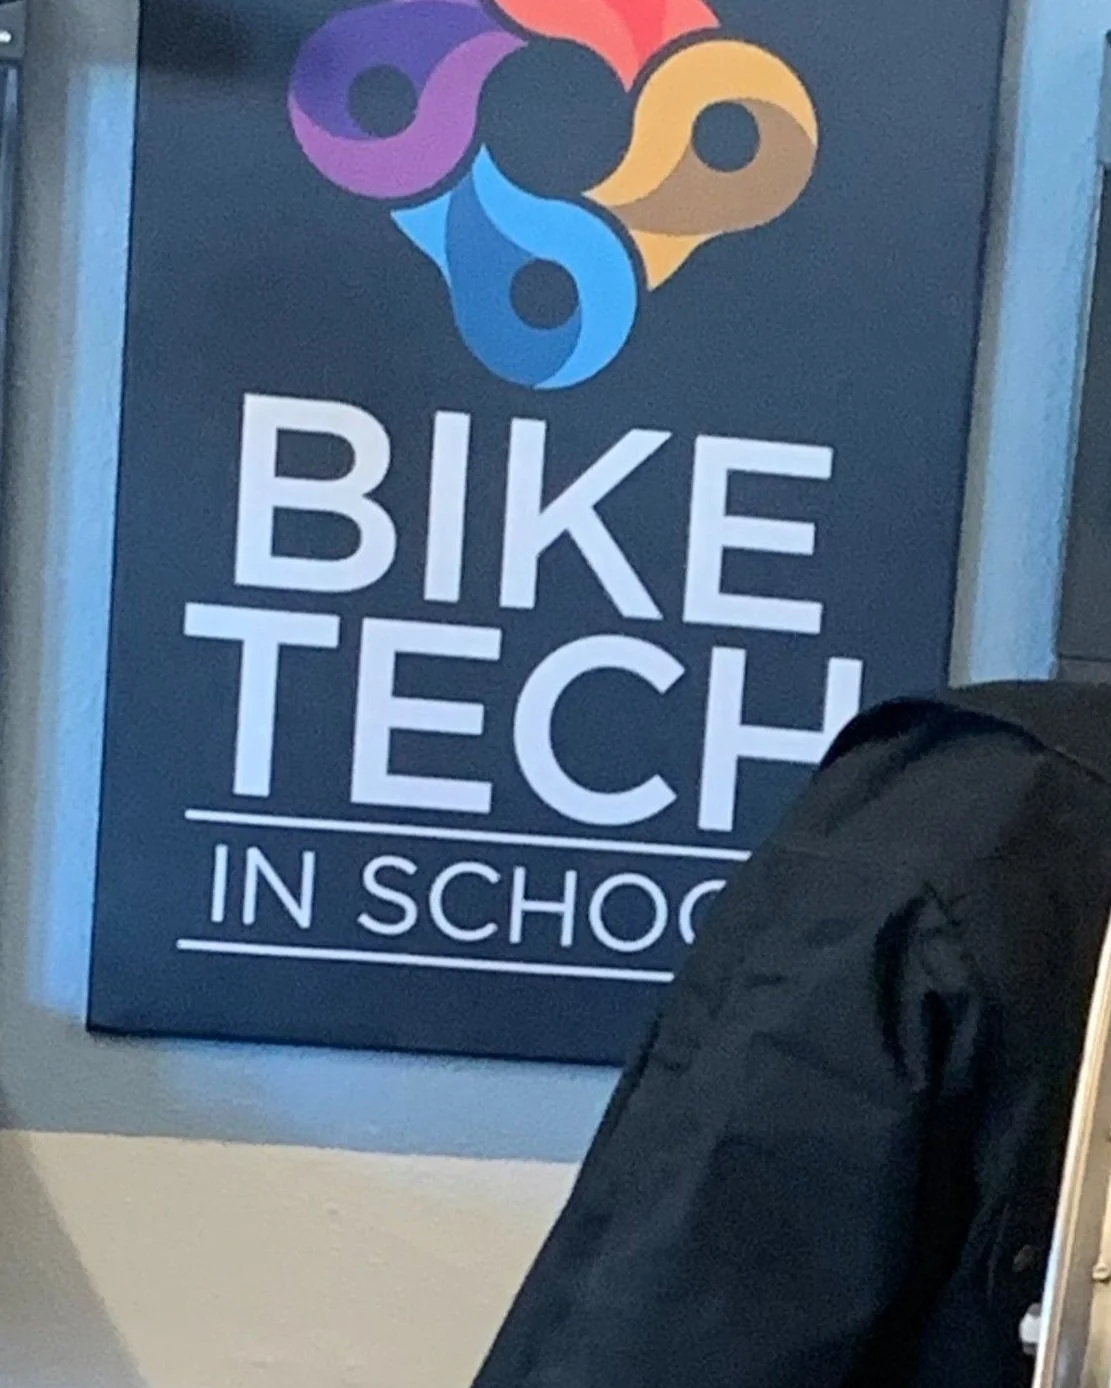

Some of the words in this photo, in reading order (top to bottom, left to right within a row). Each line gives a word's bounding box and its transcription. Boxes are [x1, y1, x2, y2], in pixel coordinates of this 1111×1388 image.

[234, 393, 833, 634] BIKE
[183, 602, 863, 832] TECH
[210, 844, 315, 929] IN
